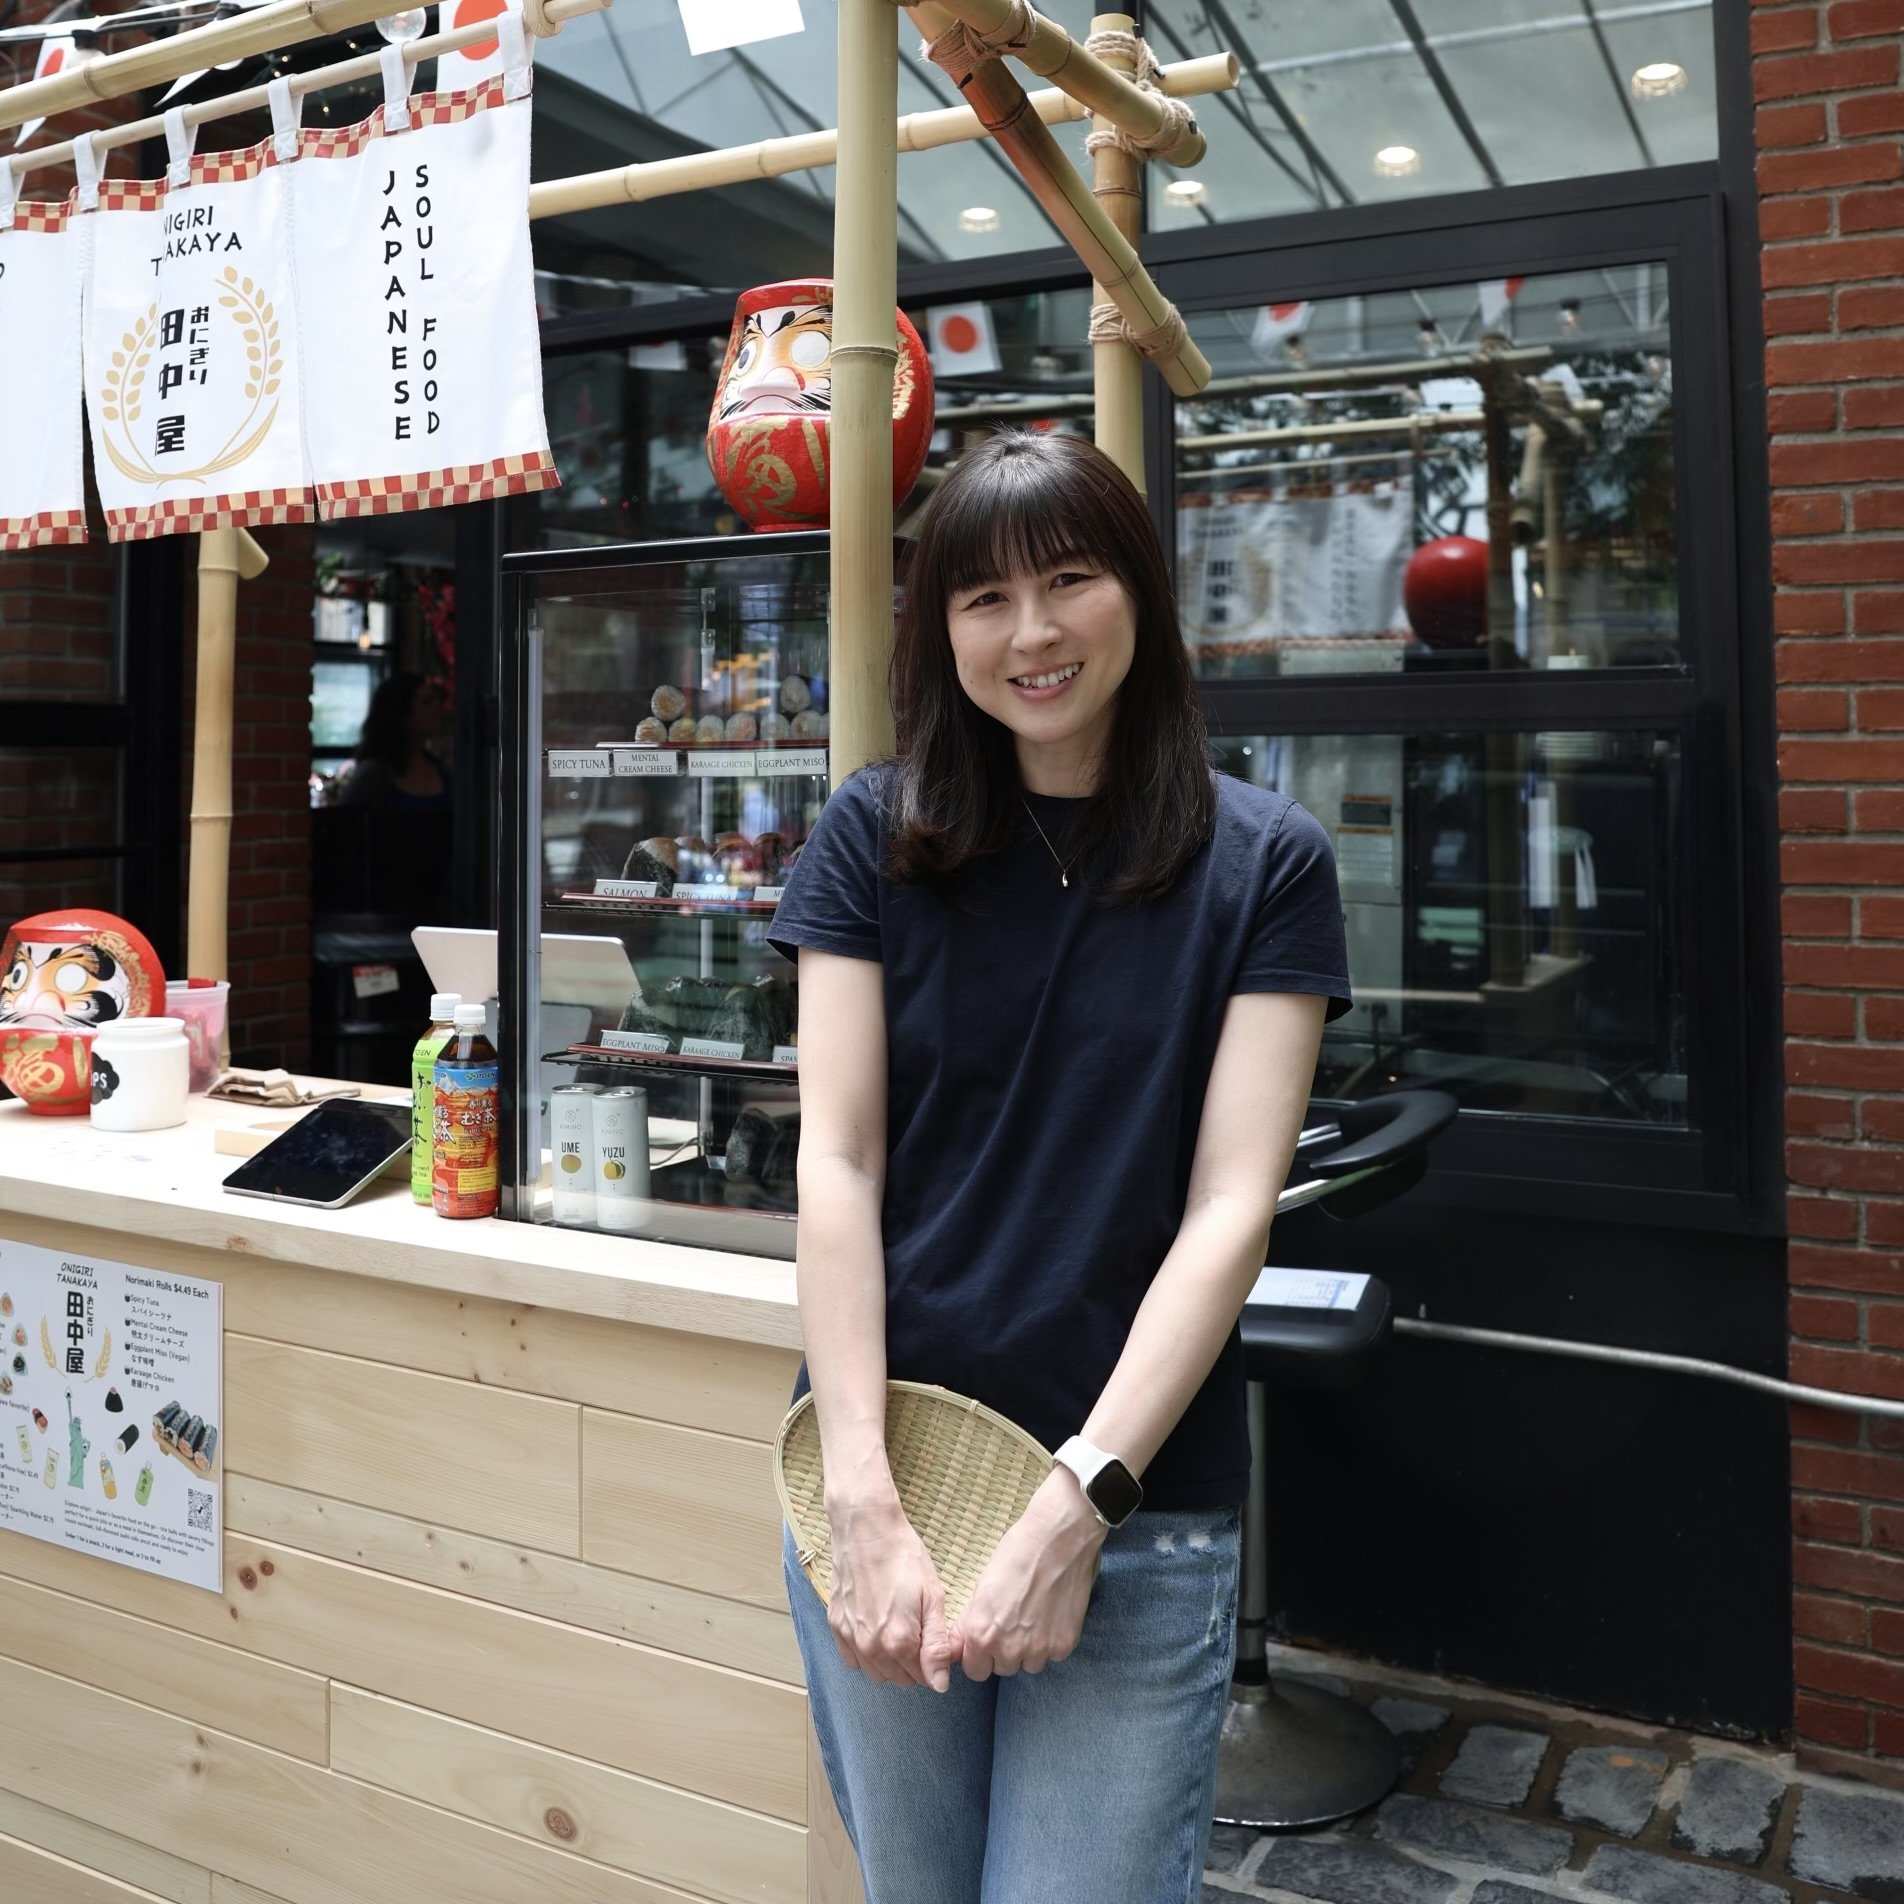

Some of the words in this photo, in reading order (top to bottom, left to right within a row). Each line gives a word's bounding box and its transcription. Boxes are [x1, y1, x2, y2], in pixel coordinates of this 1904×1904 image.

[415, 164, 434, 280] SOUL
[380, 170, 411, 440] JAPANESE
[189, 306, 209, 385] おにぎり
[155, 308, 185, 456] 田中屋
[422, 317, 440, 434] FOOD
[552, 759, 578, 769] SPICY
[580, 759, 605, 769] TUNA
[631, 753, 659, 762] MENTAI
[690, 761, 721, 769] KARAAGE
[721, 760, 753, 768] CHICKEN
[758, 759, 800, 768] EGGPLANT
[802, 757, 825, 767] MISO
[618, 765, 644, 773] CREAM
[645, 765, 673, 773] CHEESE
[602, 1038, 641, 1050] EGGPLANT
[683, 1046, 711, 1056] KARAAGE
[711, 1050, 741, 1058] CHICKEN
[561, 1142, 580, 1153] UME
[602, 1146, 625, 1158] YUZU
[60, 1262, 94, 1277] ONIGIRI
[56, 1273, 98, 1290] TANAKAYA
[125, 1274, 154, 1288] Norimaki
[156, 1280, 172, 1292] Rolls
[174, 1283, 191, 1296] $4.49
[193, 1287, 209, 1299] Each
[131, 1294, 145, 1305] Spicy
[146, 1297, 159, 1306] Tuna
[86, 1295, 94, 1337] おにぎり
[66, 1291, 85, 1374] 田中屋
[149, 1322, 167, 1333] Cream
[168, 1326, 188, 1337] Cheese
[131, 1342, 154, 1355] Eggplant
[155, 1346, 168, 1357] Miso
[168, 1350, 190, 1364] (Vegan)
